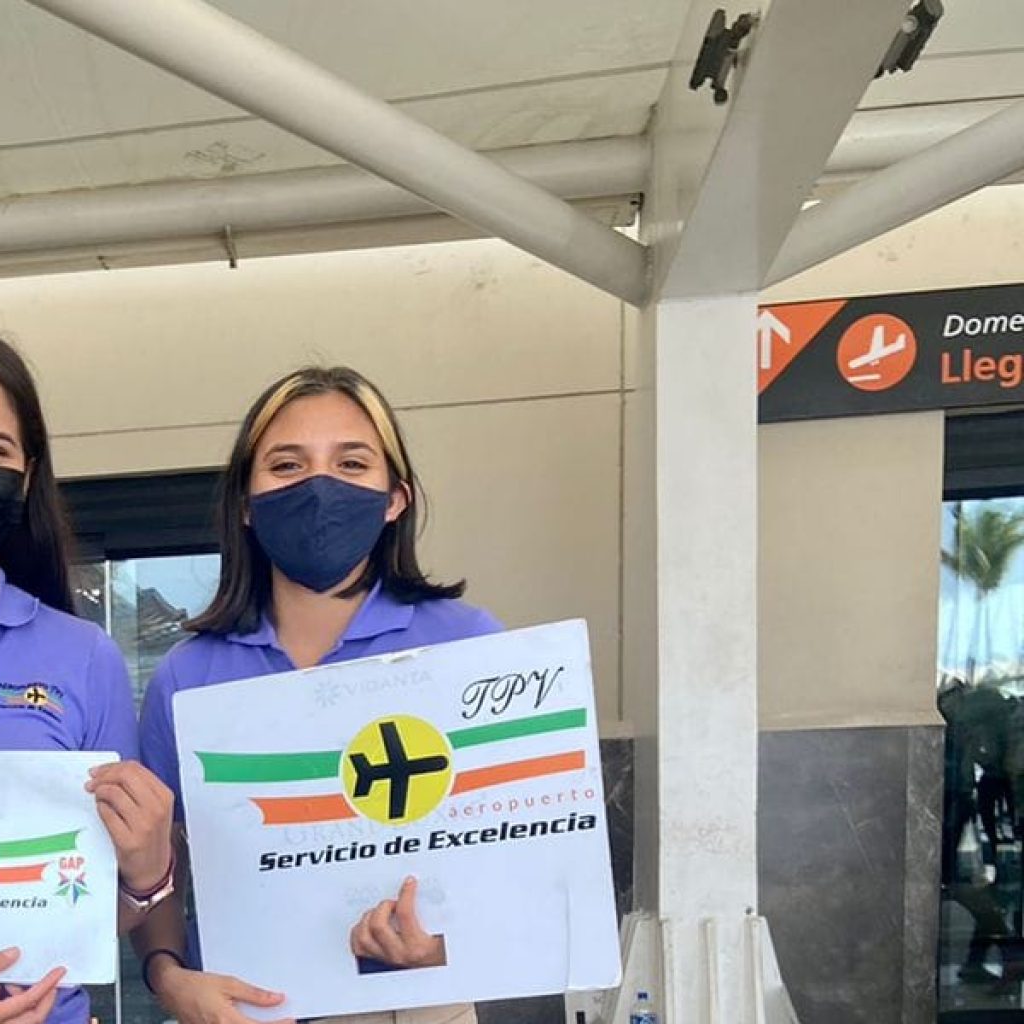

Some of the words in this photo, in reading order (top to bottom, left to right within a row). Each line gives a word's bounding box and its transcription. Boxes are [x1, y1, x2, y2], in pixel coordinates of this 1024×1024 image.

[941, 348, 1024, 388] Lleg
[461, 666, 564, 719] TPV
[448, 788, 595, 818] aeropuerto
[259, 842, 376, 871] Servicio
[383, 836, 422, 856] de
[428, 812, 597, 850] Excelencia
[58, 855, 85, 870] GAP
